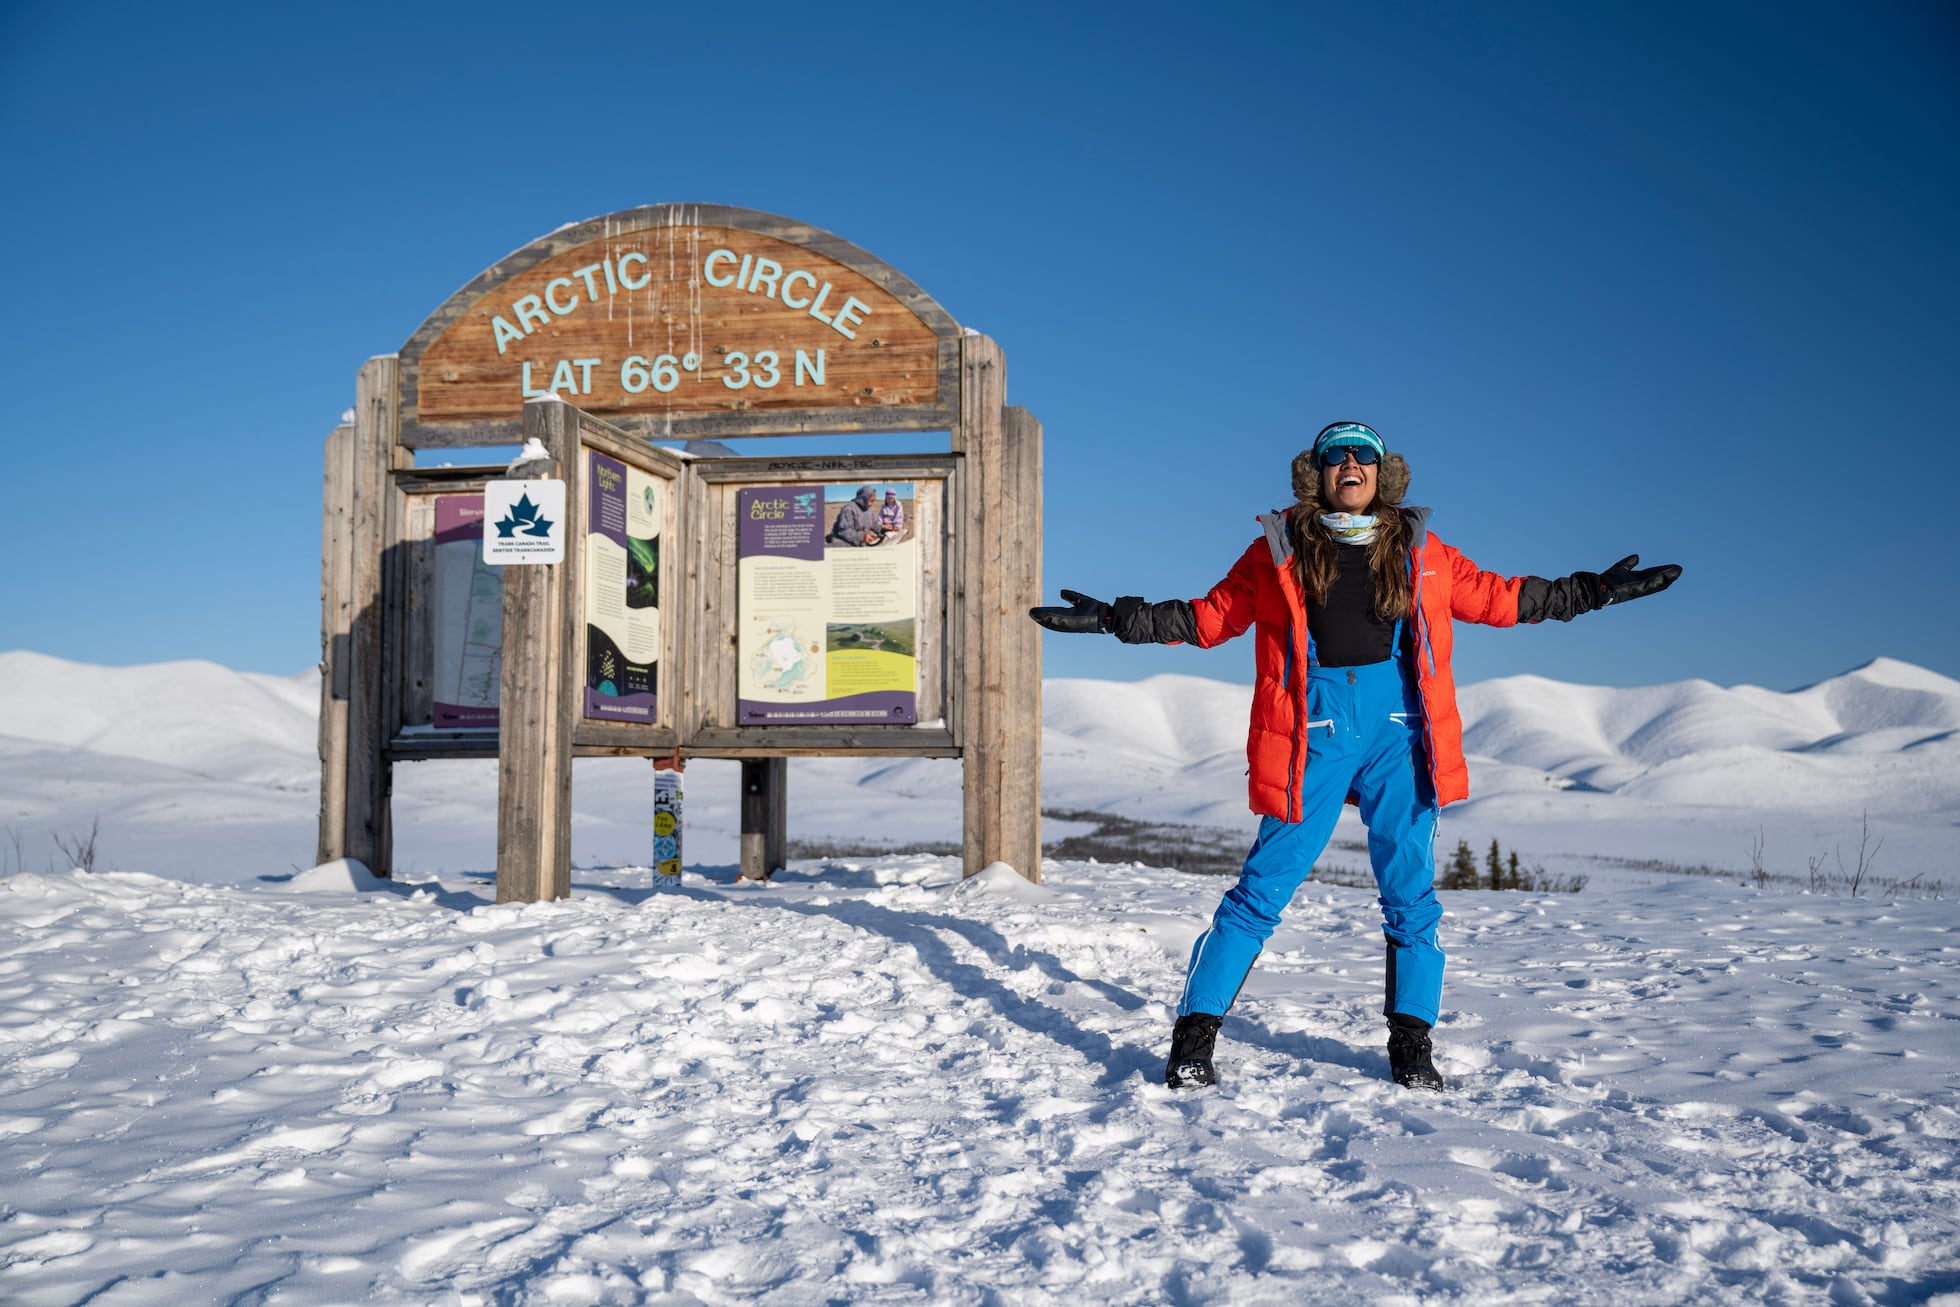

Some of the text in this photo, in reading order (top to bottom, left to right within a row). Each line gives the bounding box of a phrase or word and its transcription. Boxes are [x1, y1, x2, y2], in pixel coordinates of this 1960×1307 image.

[491, 249, 872, 355] ARCTIC CIRCLE
[522, 358, 601, 397] LAT
[722, 351, 781, 389] 33
[795, 348, 826, 386] N
[597, 464, 621, 483] Northern
[598, 475, 616, 491] Lights
[751, 499, 790, 510] Arctic
[750, 510, 784, 520] Circle
